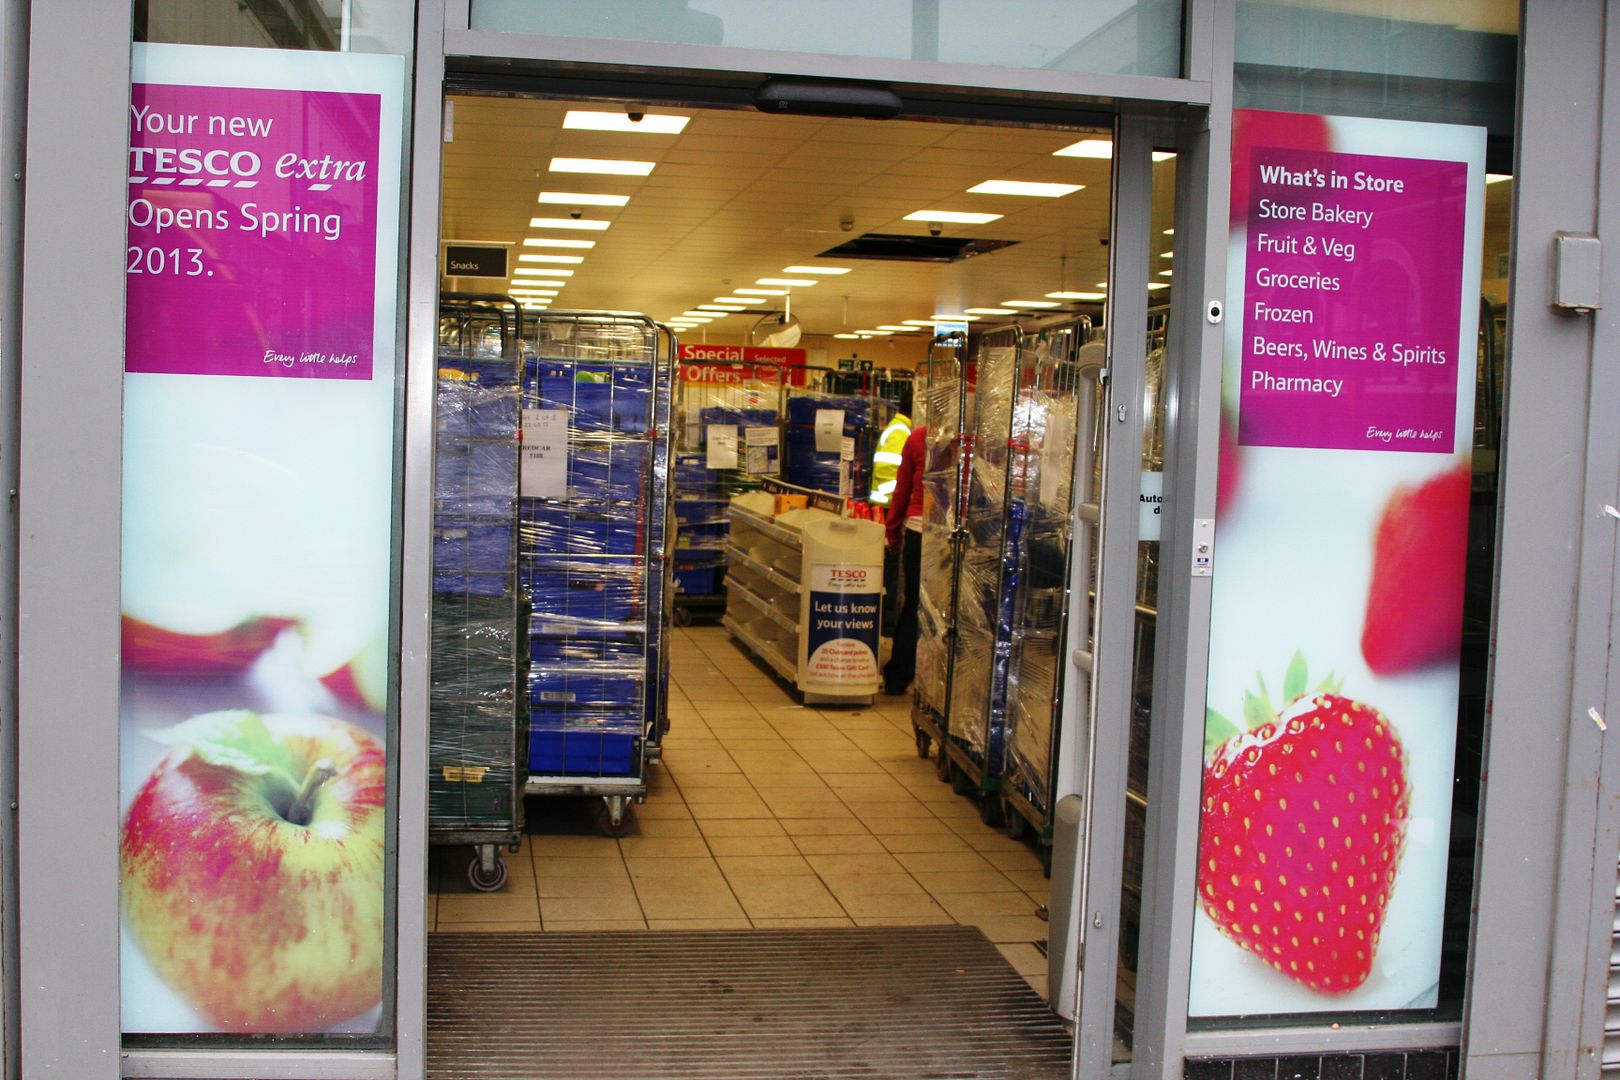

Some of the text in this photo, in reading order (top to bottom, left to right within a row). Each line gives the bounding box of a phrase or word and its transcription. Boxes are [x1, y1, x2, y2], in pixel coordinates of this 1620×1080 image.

[131, 104, 273, 137] Your new
[129, 147, 367, 182] TESCO extra
[1331, 171, 1347, 188] in
[1354, 172, 1404, 192] Store
[128, 198, 340, 240] Opens Spring
[1259, 199, 1373, 228] Store Bakery
[1258, 233, 1354, 261] Fruit & Veg
[127, 246, 214, 276] 2013.
[450, 260, 479, 270] Snacks
[1257, 268, 1340, 290] Groceries
[1255, 302, 1312, 323] Frozen
[264, 350, 357, 367] Every little helps
[684, 345, 744, 361] Special
[1254, 336, 1445, 366] Beers, Wines & Spirits
[687, 366, 741, 384] Offers
[1252, 371, 1343, 397] Pharmacy
[1366, 426, 1442, 442] Every little helps
[1140, 494, 1163, 503] Auto
[831, 569, 867, 578] TESCO
[815, 601, 877, 614] Let us know
[816, 618, 874, 630] your views
